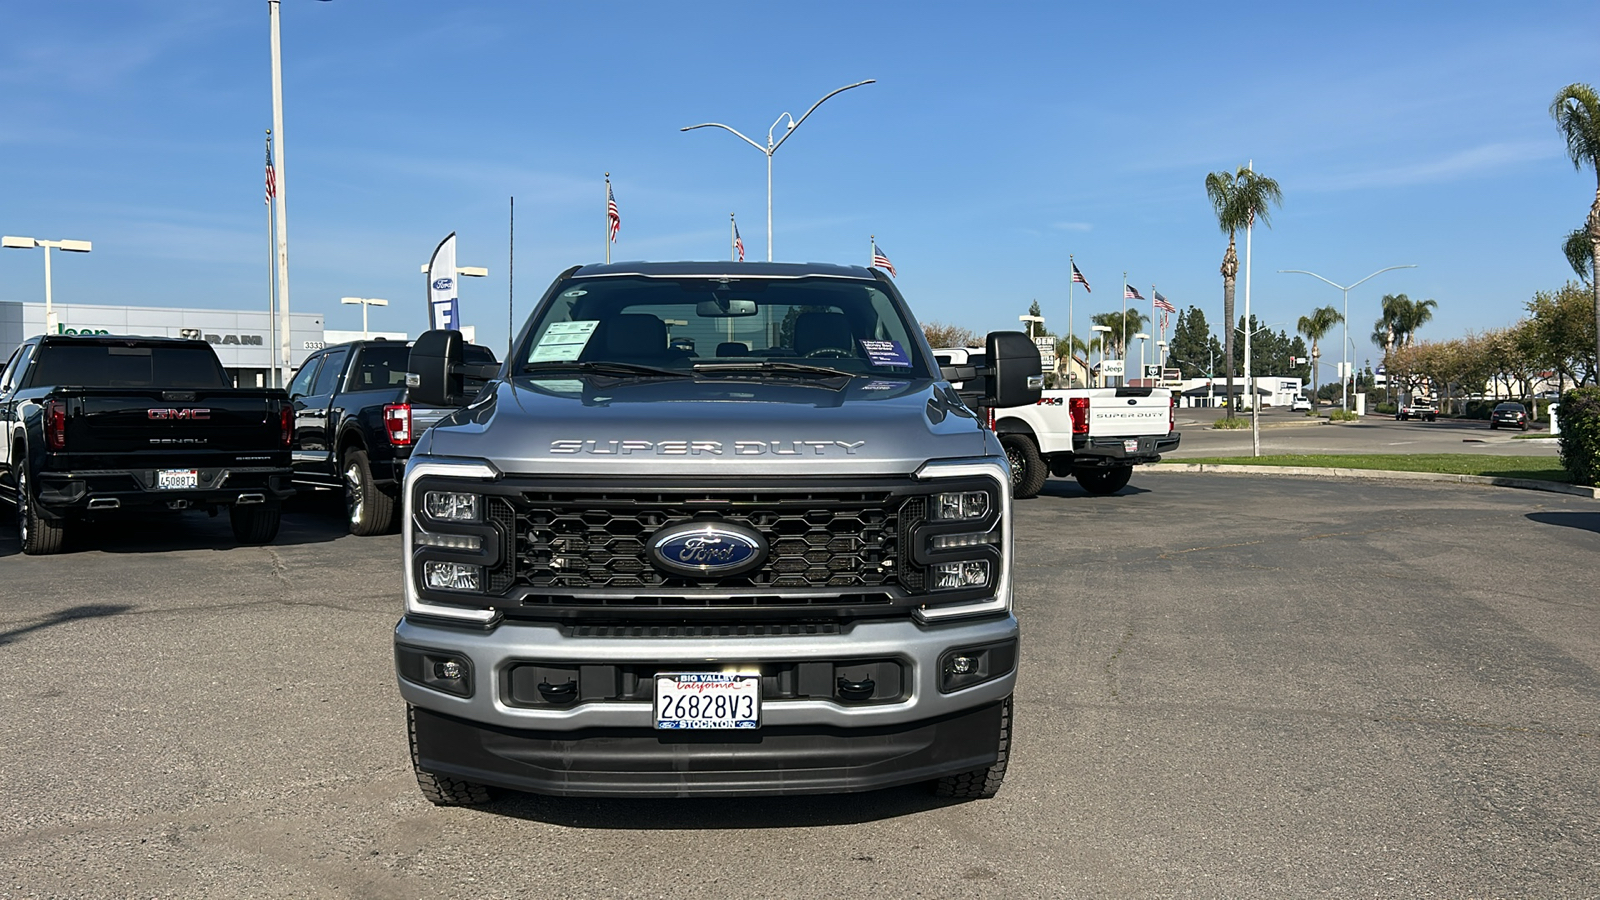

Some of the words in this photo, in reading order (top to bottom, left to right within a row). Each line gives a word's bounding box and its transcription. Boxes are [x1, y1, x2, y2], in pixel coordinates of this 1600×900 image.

[204, 334, 263, 346] RAM
[1035, 337, 1054, 345] OEM
[304, 342, 323, 350] 3333
[1104, 365, 1123, 373] Jeep
[147, 408, 210, 420] GMC
[550, 439, 723, 455] SUPER
[734, 439, 865, 455] DUTY
[160, 476, 196, 486] 45088T3
[679, 537, 734, 561] Ford
[676, 682, 741, 693] California
[661, 695, 753, 719] 26828V3
[679, 720, 736, 729] STOCKTON
